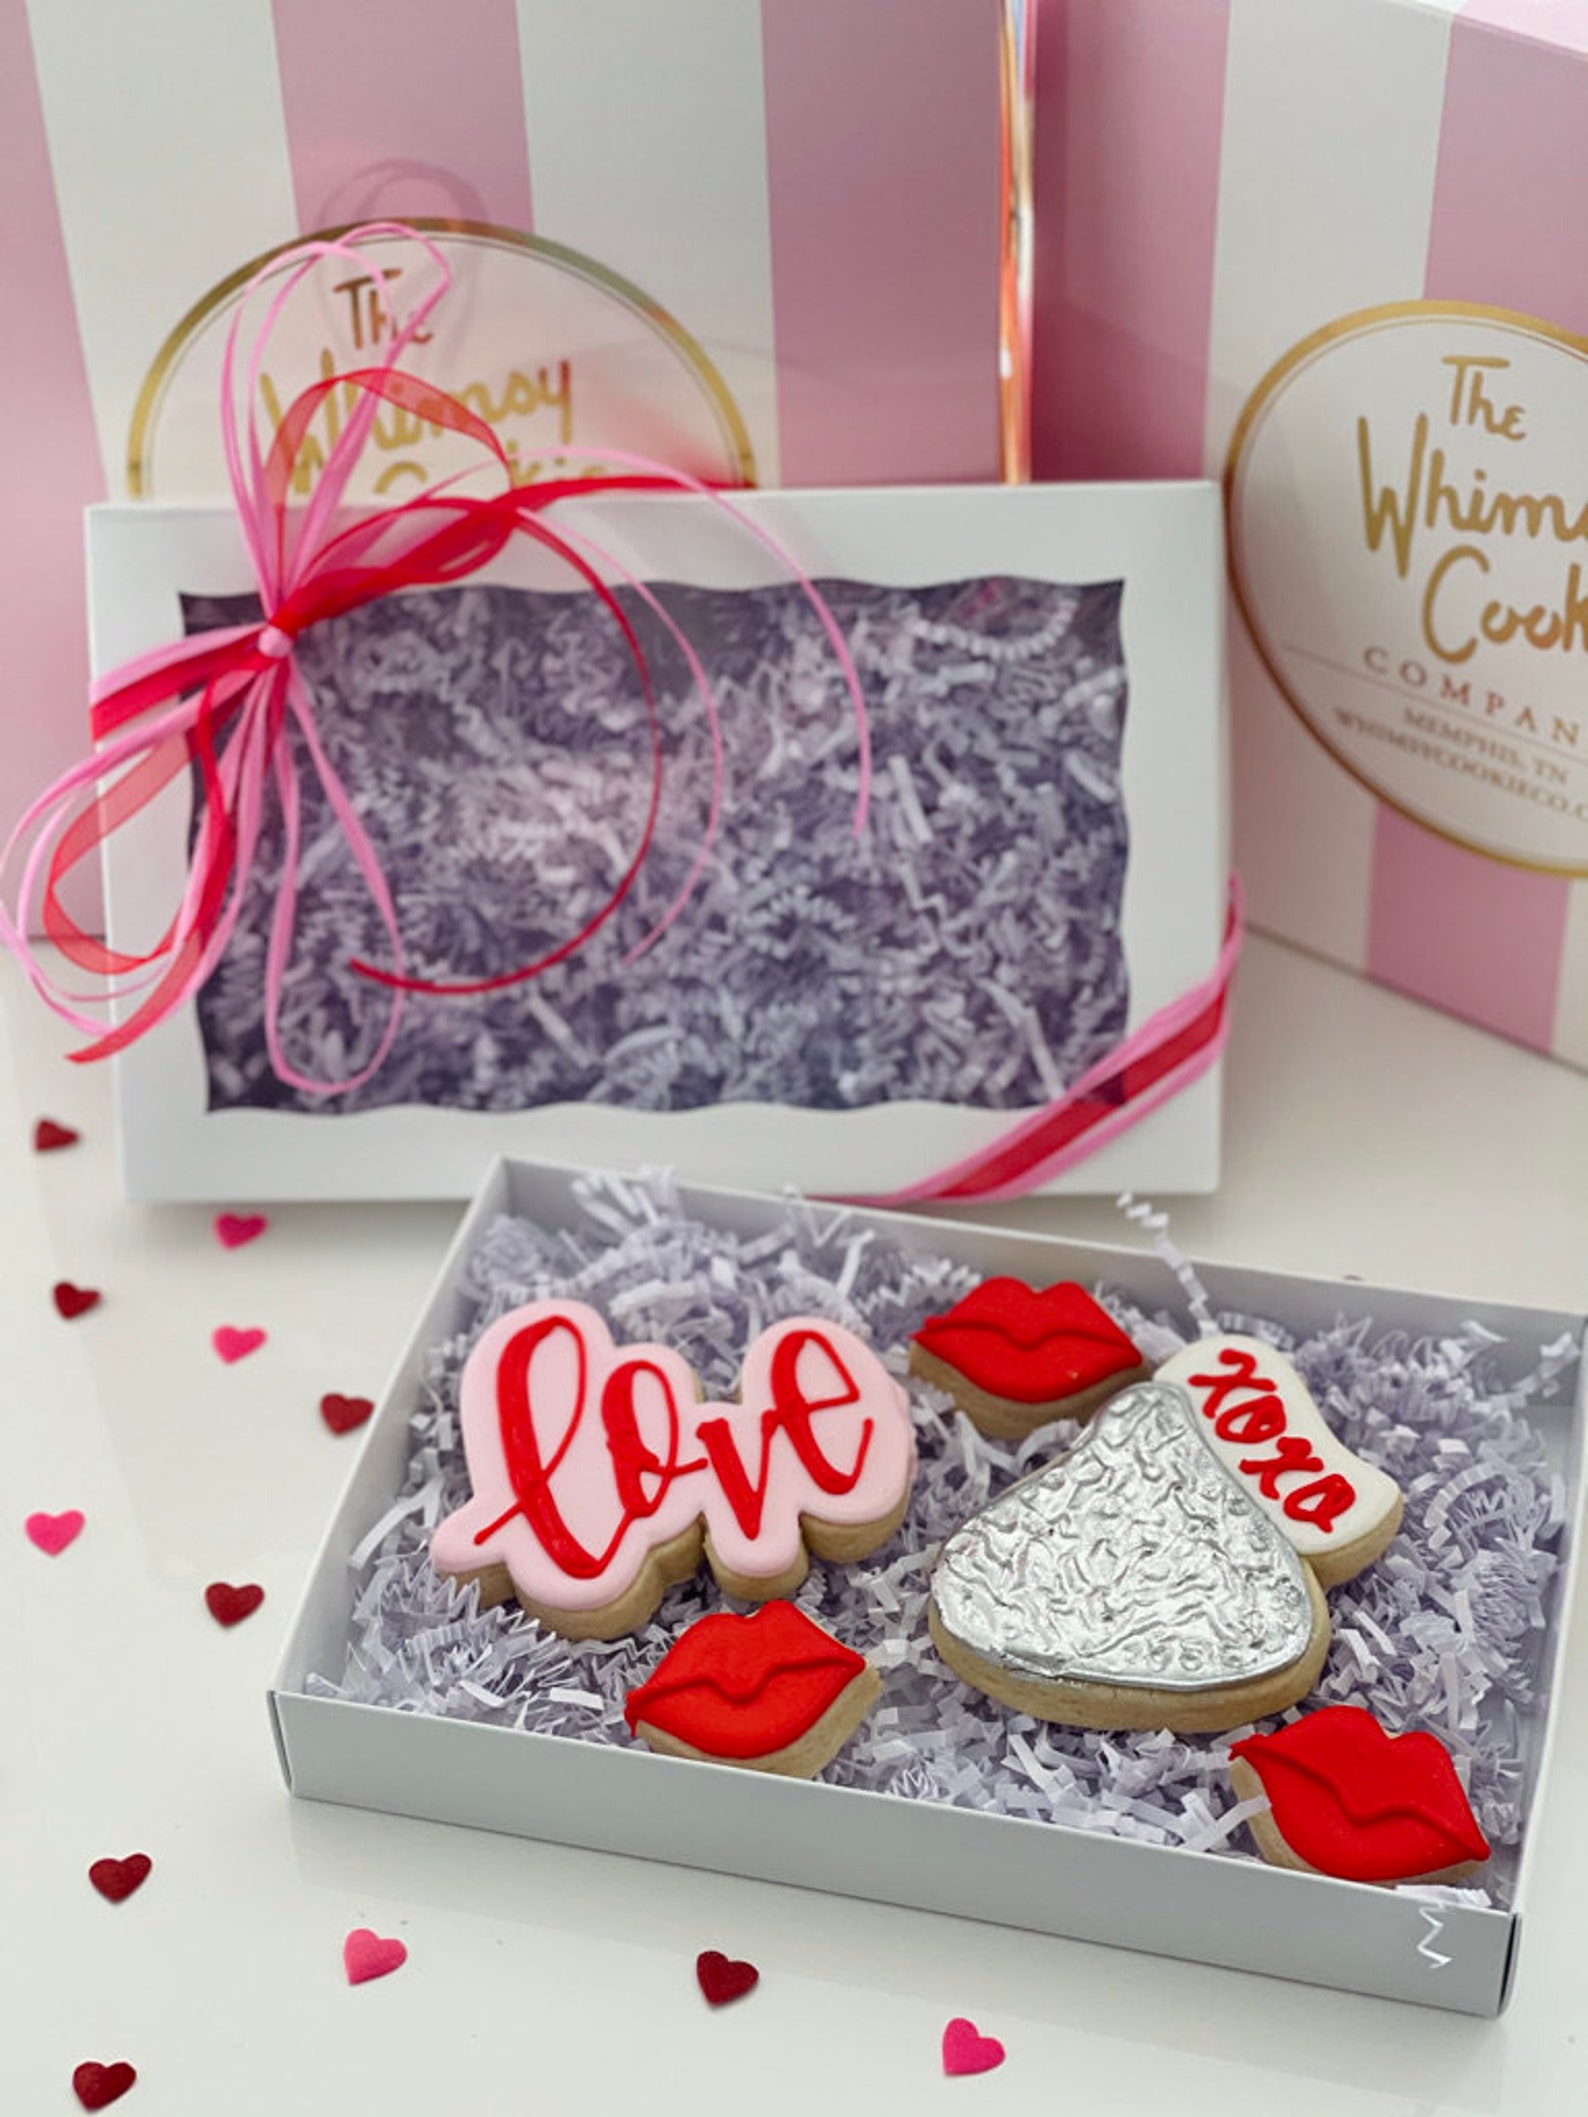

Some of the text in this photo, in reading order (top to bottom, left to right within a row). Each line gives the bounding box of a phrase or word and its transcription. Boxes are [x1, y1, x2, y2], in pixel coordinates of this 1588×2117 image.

[1441, 355, 1527, 441] The
[1363, 645, 1579, 746] COMPAN
[1532, 754, 1569, 785] TN
[474, 1315, 874, 1579] love
